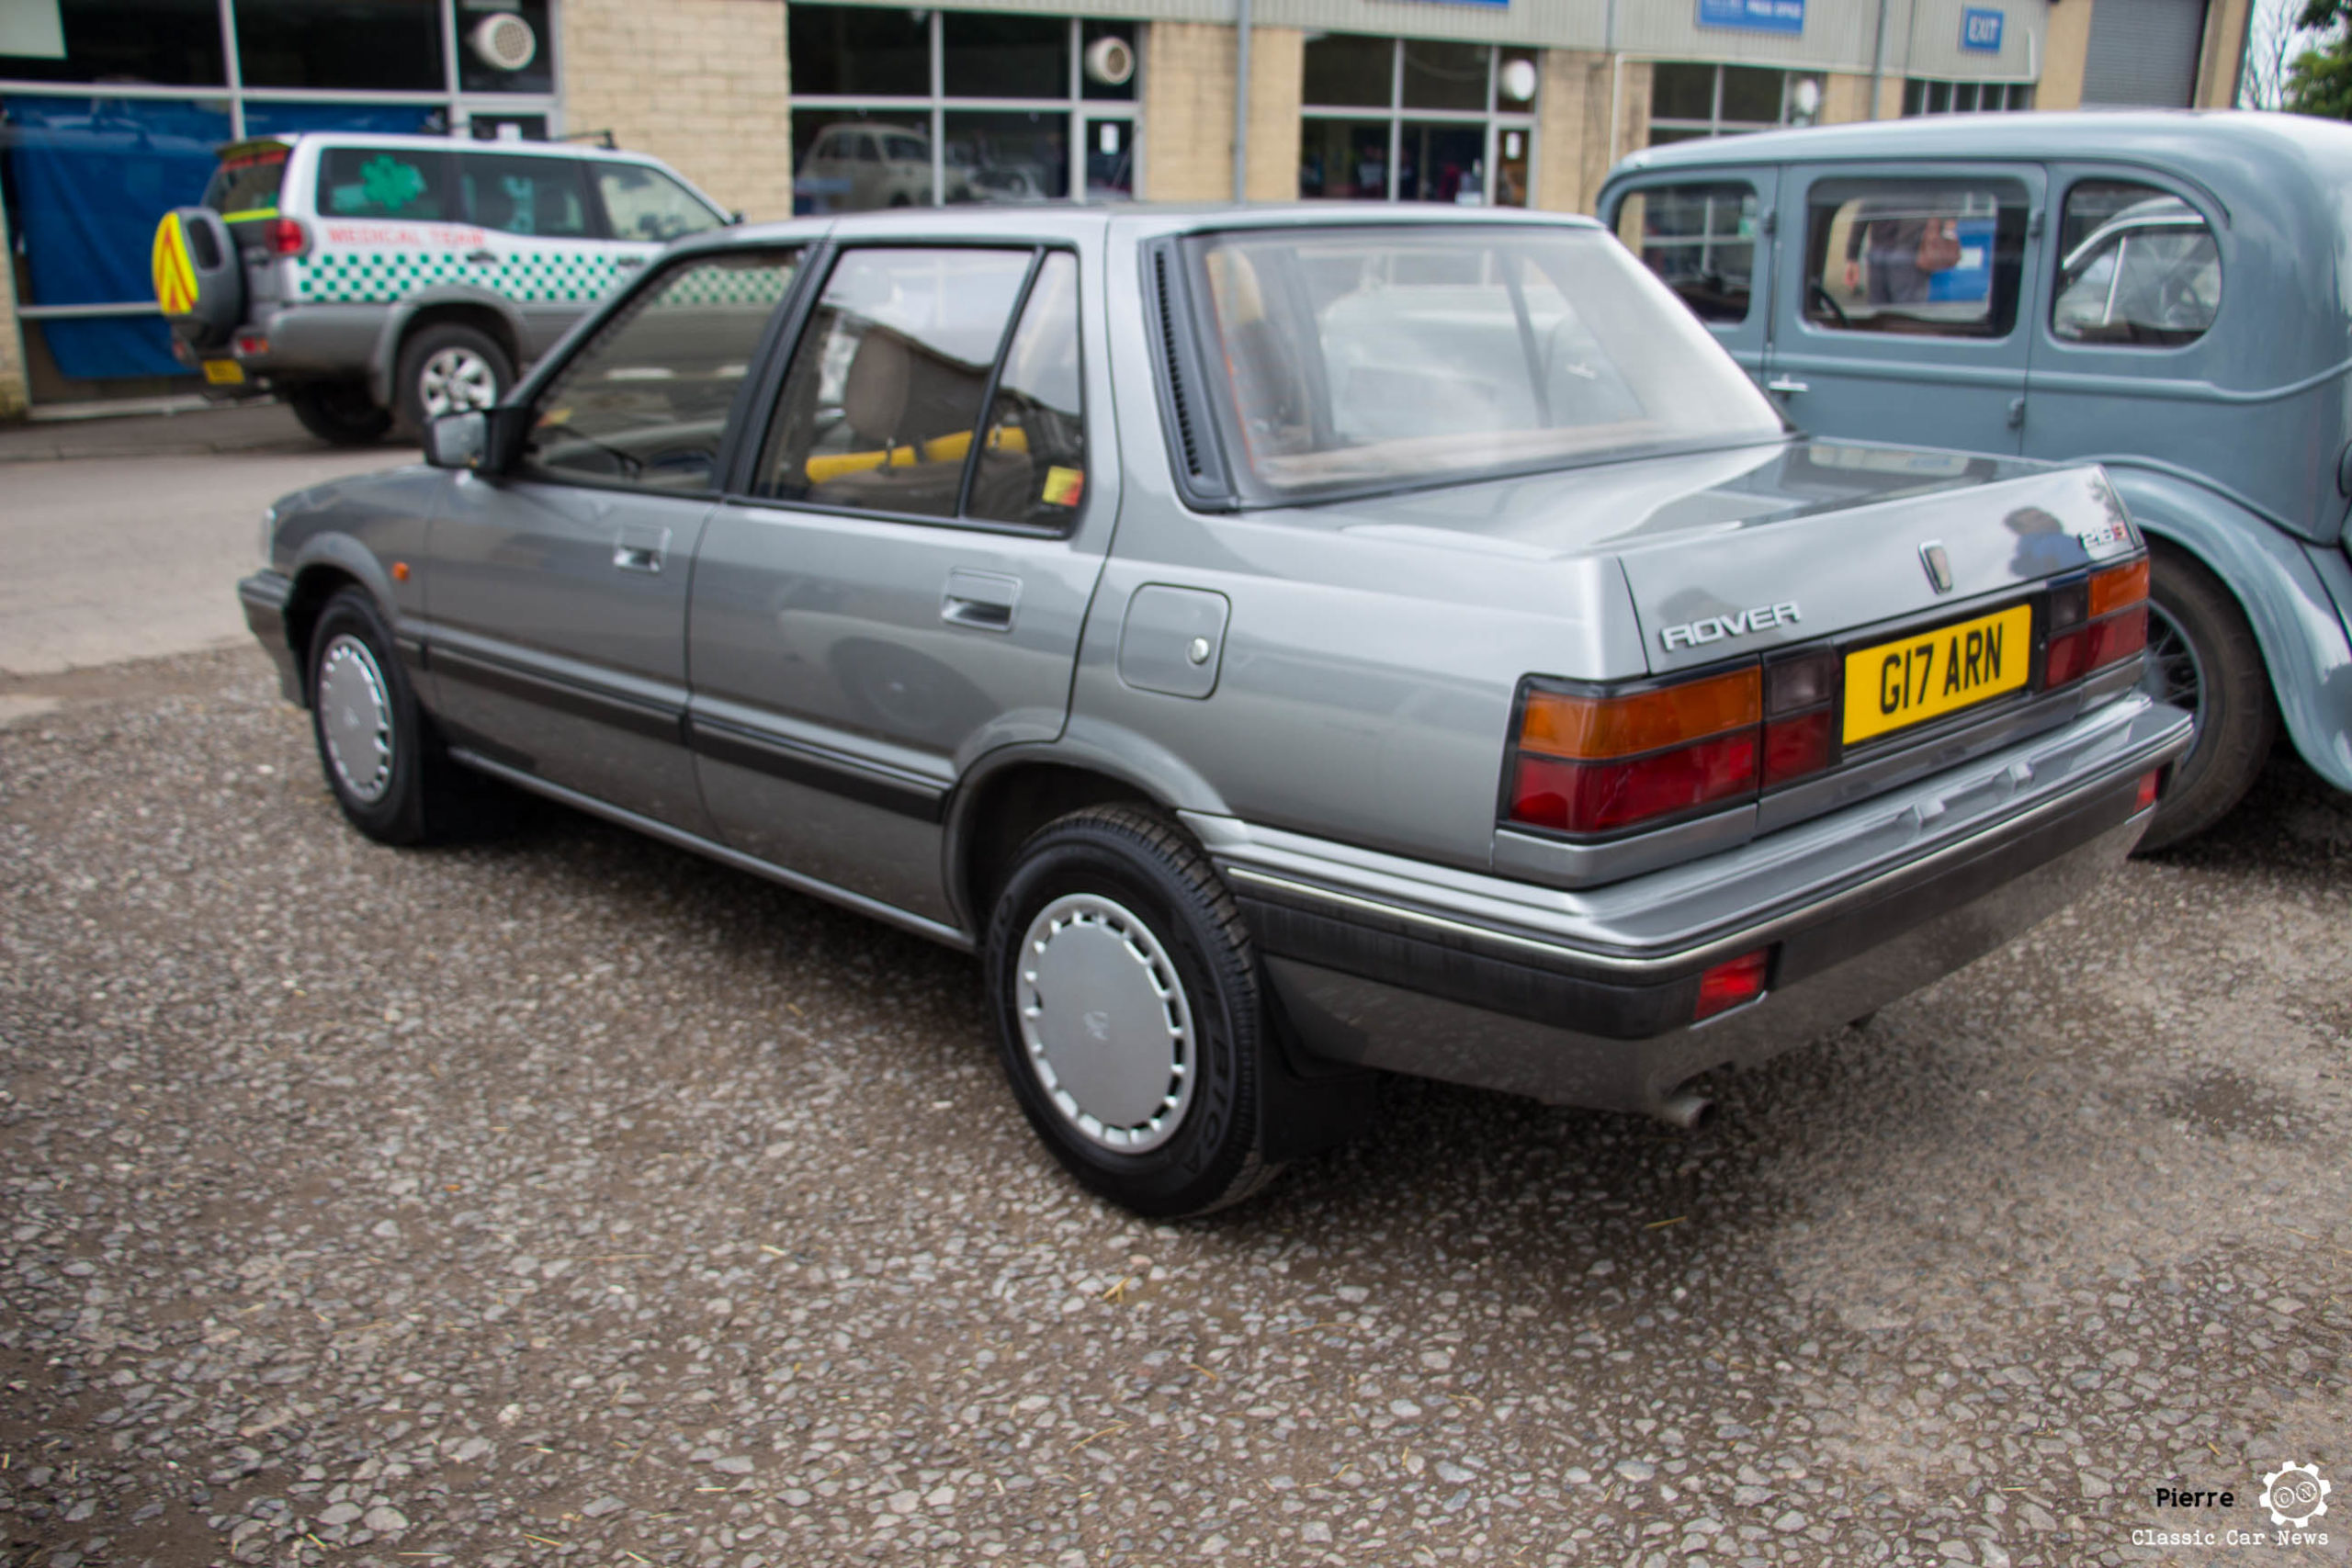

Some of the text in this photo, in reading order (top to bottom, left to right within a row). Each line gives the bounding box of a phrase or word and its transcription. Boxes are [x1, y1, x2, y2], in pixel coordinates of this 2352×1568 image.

[1968, 15, 2000, 44] EXIT
[327, 228, 486, 248] MEDICAL TEAM
[1661, 601, 1801, 651] ROVER
[1880, 622, 2003, 715] G17 ARN
